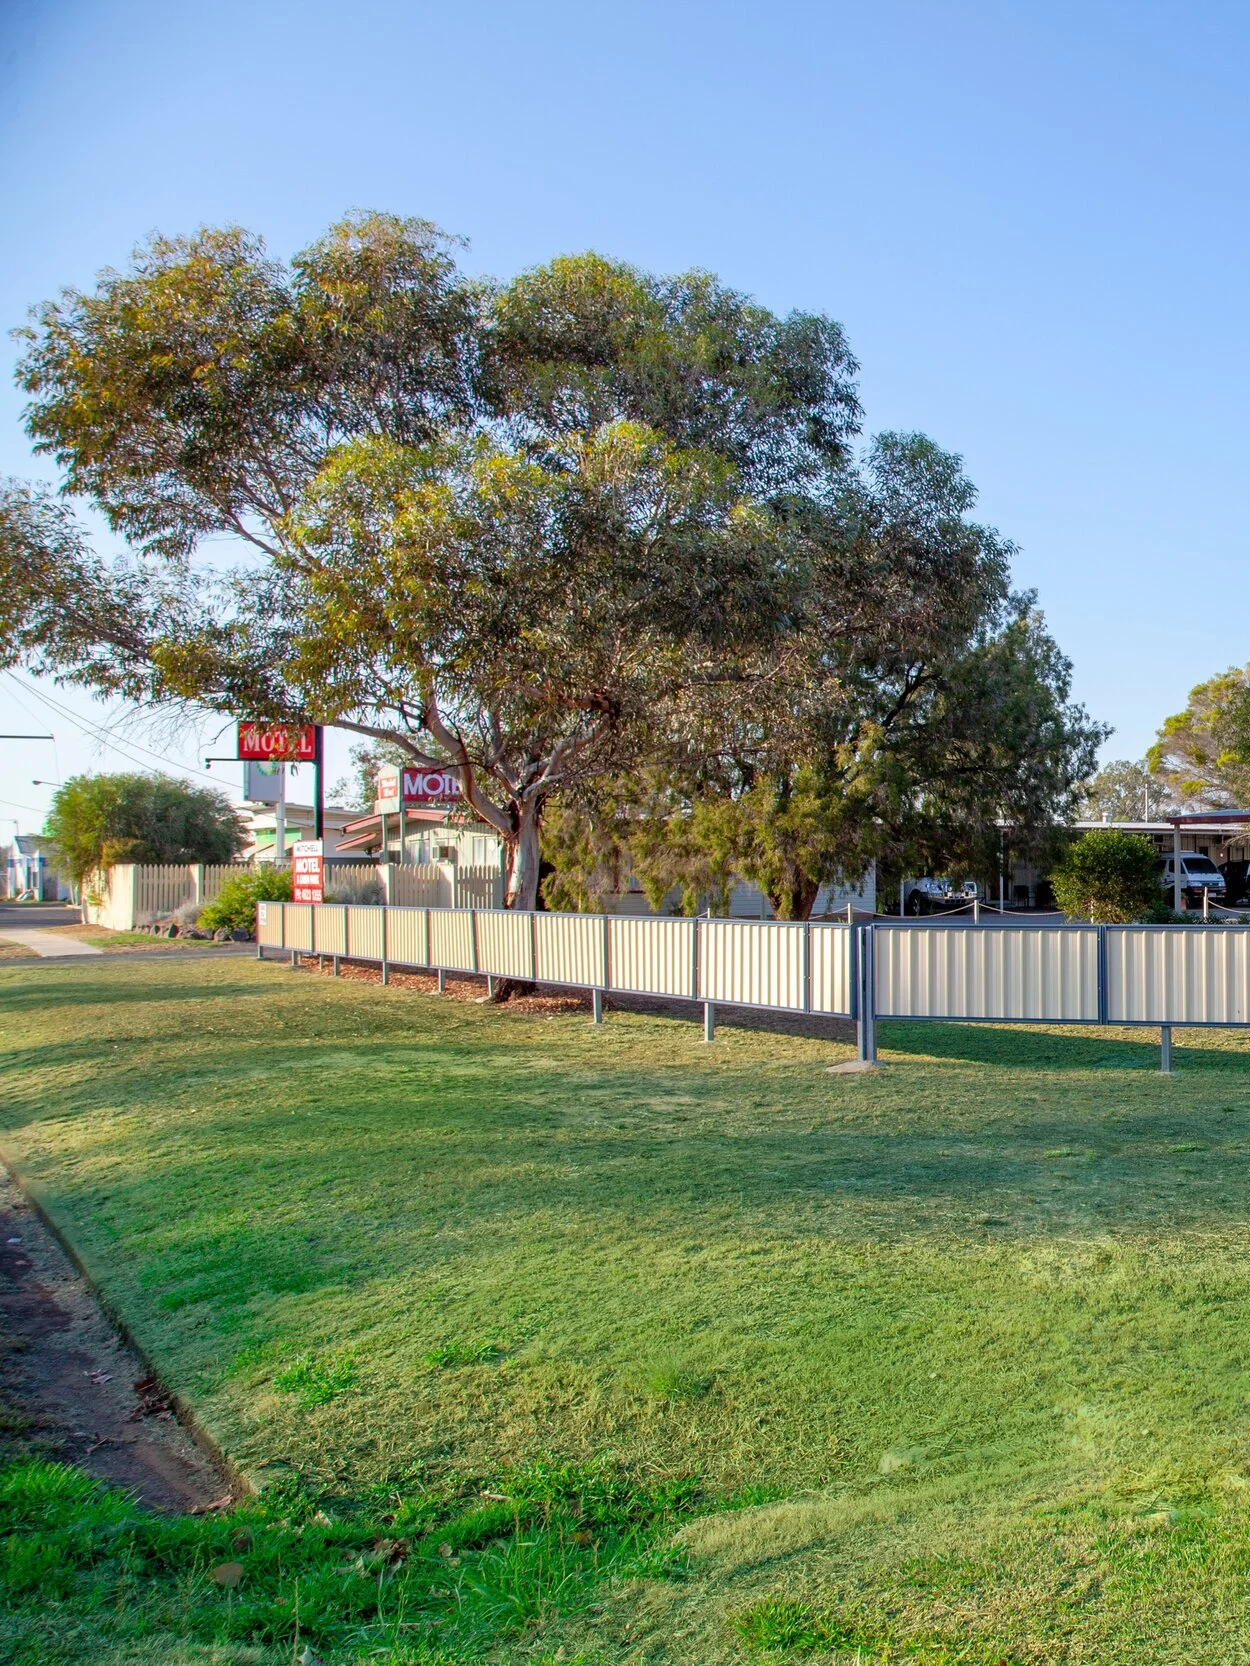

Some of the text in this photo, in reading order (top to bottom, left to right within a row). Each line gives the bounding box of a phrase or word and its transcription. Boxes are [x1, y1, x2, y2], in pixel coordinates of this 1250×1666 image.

[243, 730, 312, 753] MOTL
[404, 773, 460, 796] MOTE
[295, 857, 320, 873] MOTEL
